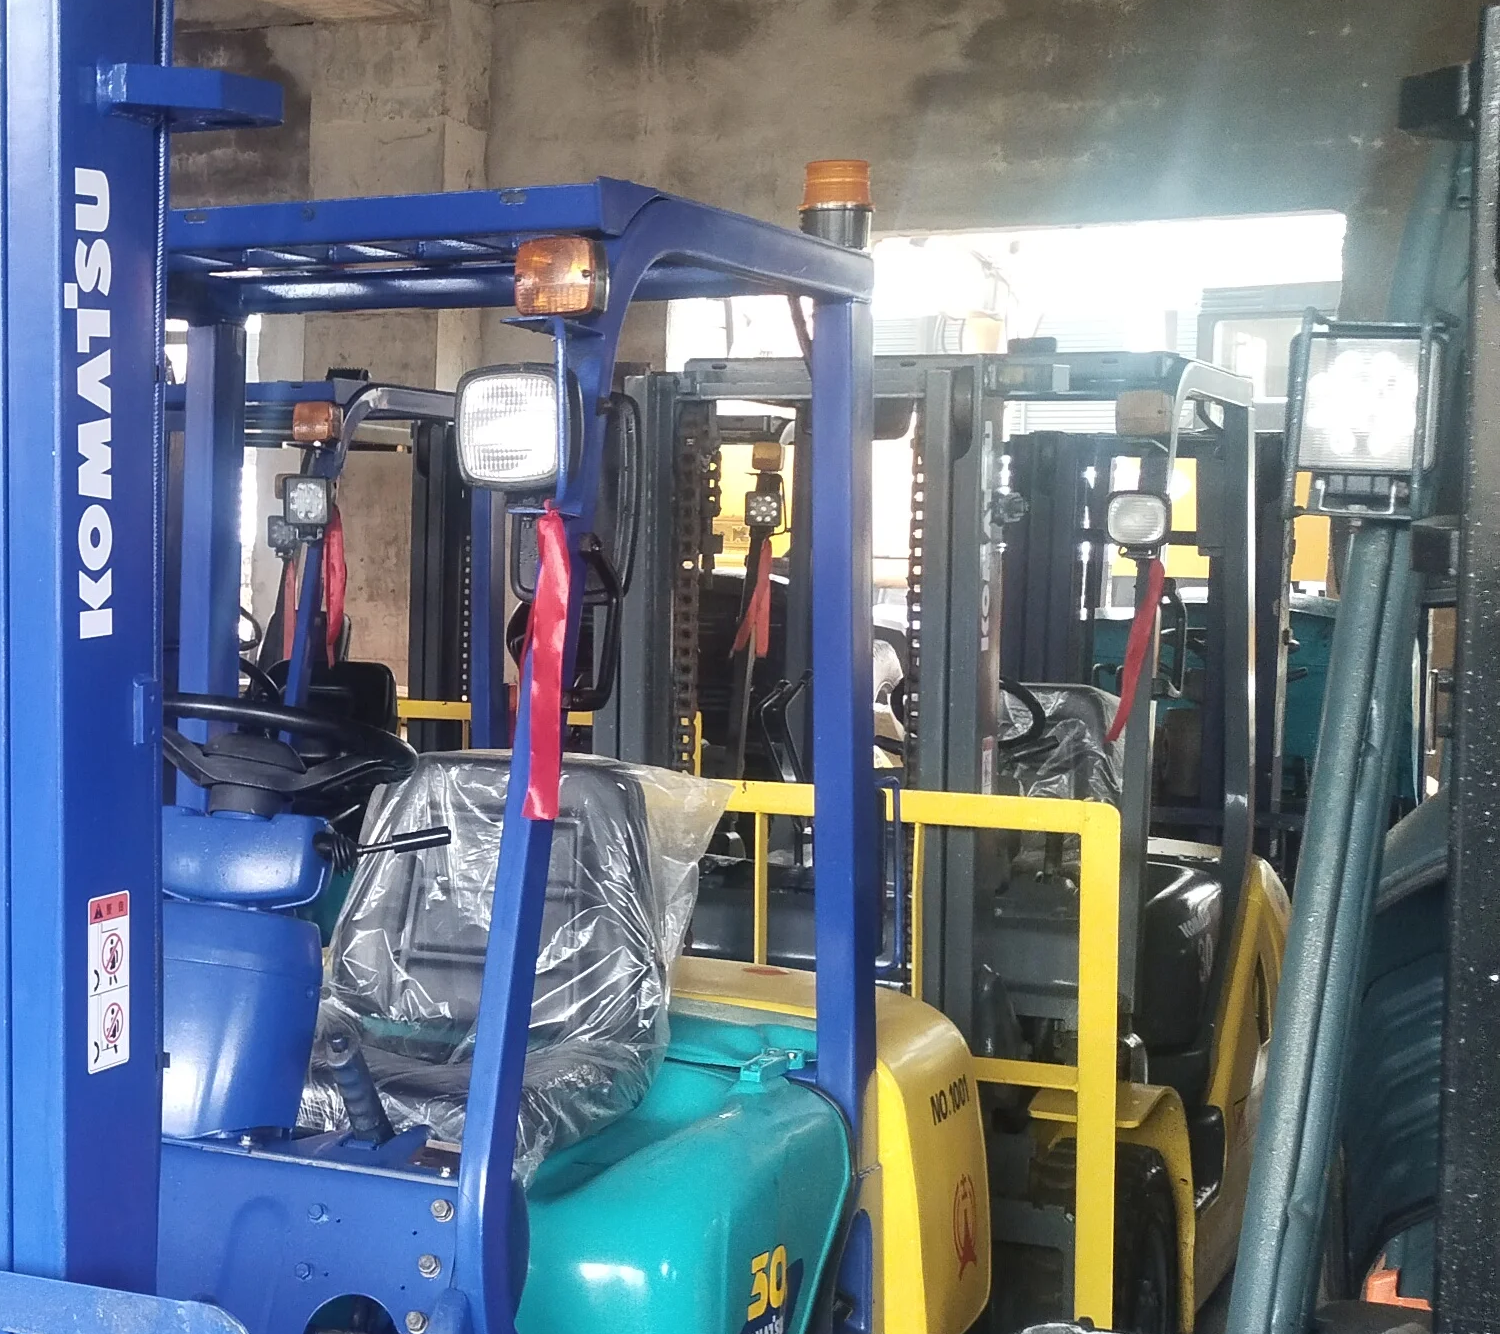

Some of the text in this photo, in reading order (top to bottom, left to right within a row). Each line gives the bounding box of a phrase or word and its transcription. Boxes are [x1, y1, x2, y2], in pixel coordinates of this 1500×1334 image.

[64, 167, 113, 639] KOMATSU
[980, 420, 993, 652] KOMATU
[747, 1245, 787, 1322] 30
